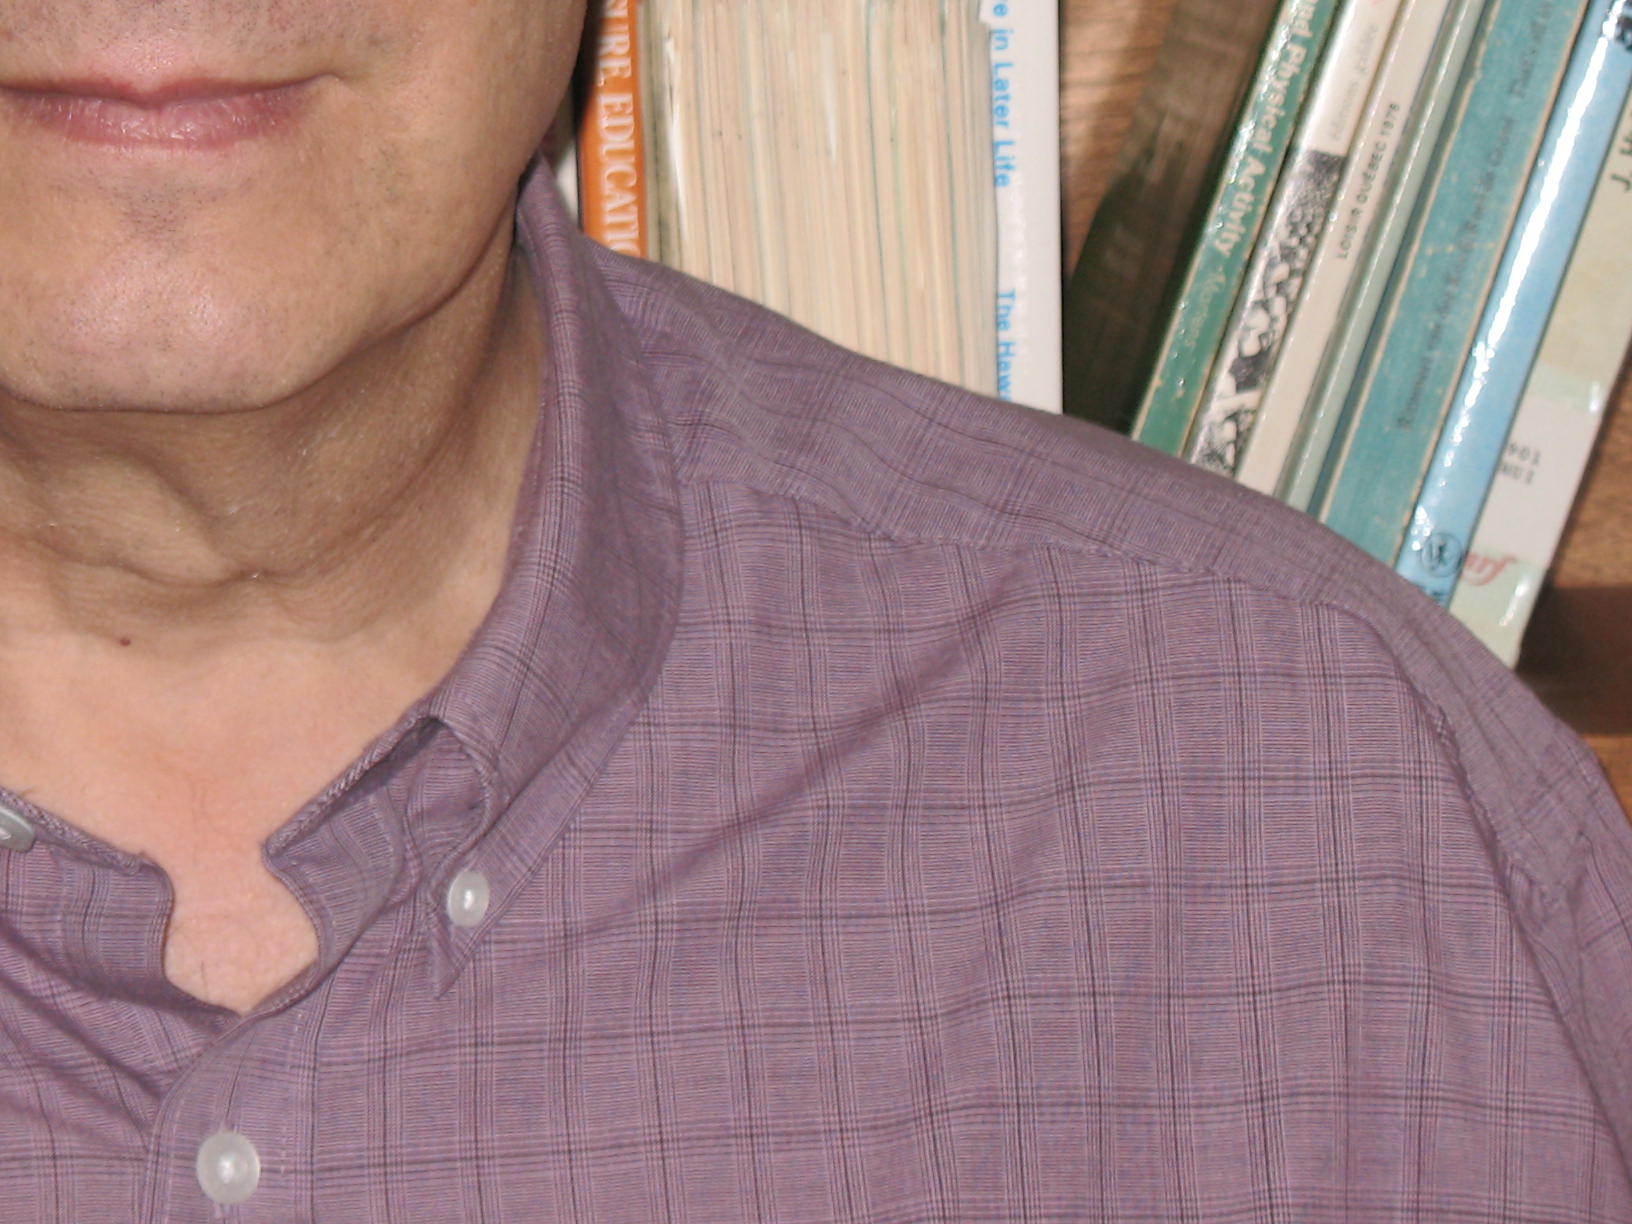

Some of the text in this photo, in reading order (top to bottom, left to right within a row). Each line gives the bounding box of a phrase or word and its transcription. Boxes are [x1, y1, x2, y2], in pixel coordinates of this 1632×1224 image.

[991, 27, 1015, 52] in
[991, 60, 1016, 129] Later
[1245, 38, 1312, 155] Physical
[993, 138, 1017, 189] Life
[1211, 154, 1271, 259] Activity
[995, 287, 1017, 328] The
